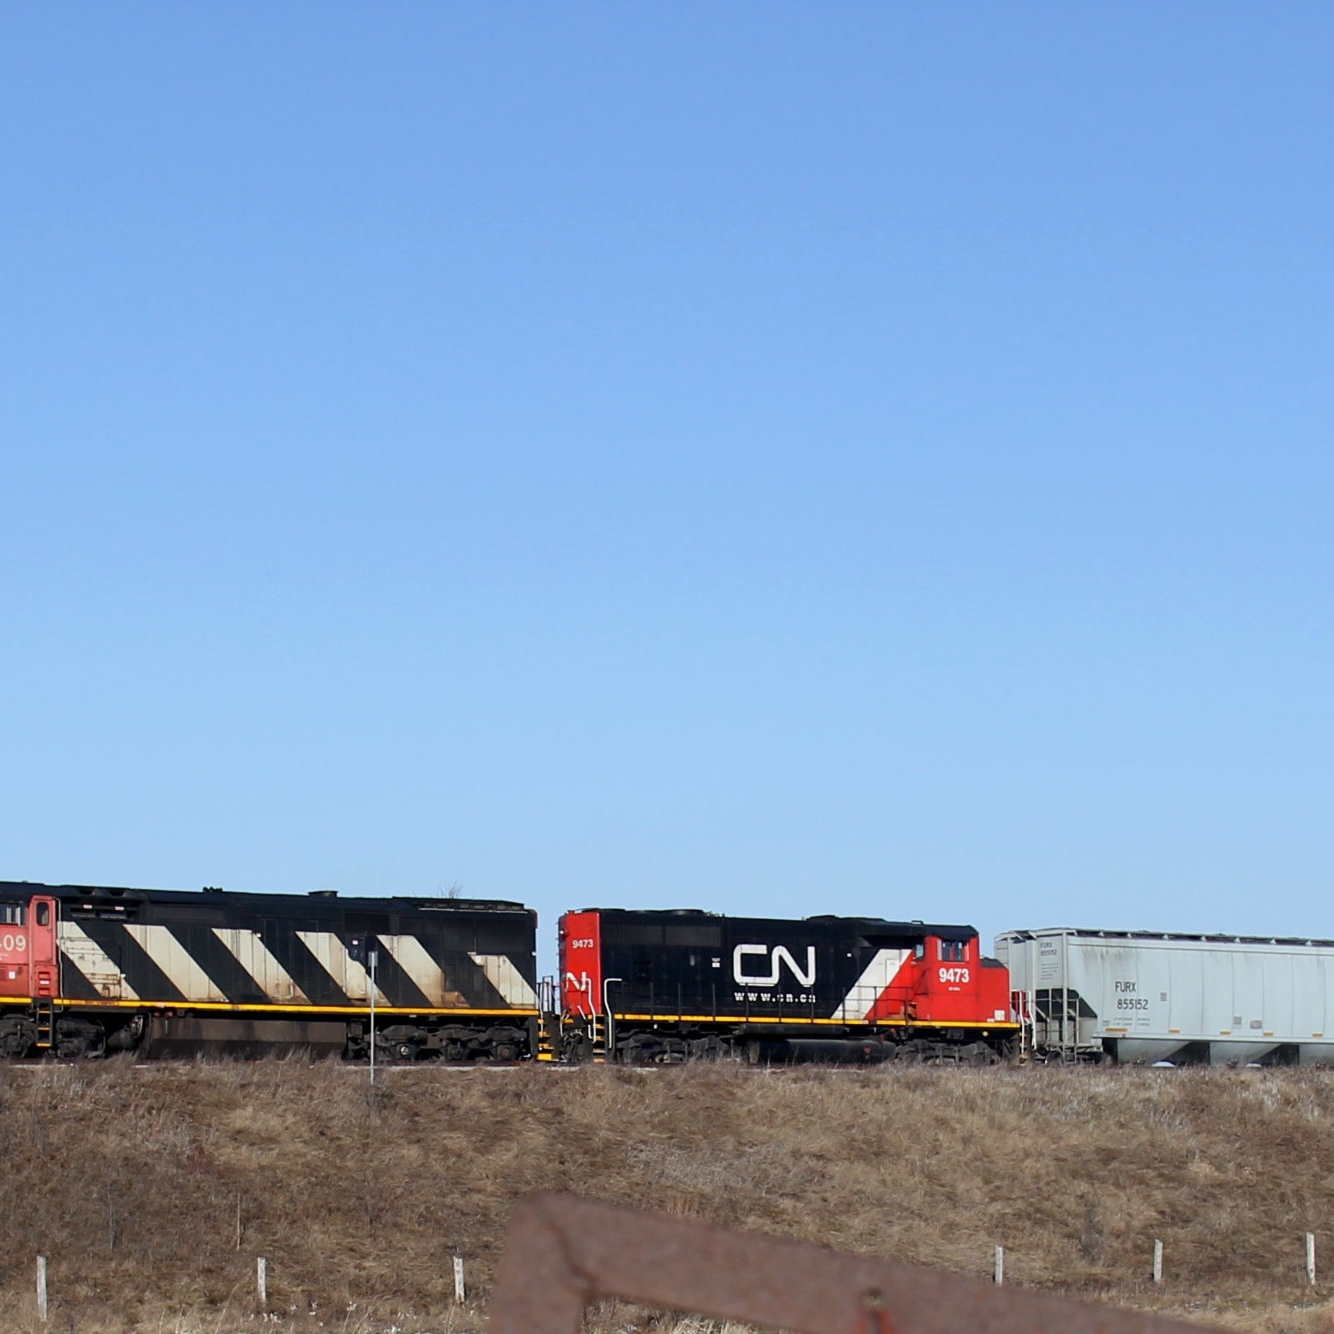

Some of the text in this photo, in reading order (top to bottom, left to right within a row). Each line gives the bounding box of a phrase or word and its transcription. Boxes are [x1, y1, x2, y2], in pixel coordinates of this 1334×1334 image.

[572, 939, 594, 949] 9473
[733, 944, 816, 987] CN
[938, 967, 970, 983] 9473
[1115, 981, 1136, 992] FURX
[734, 992, 816, 1003] www.cn.ca
[1117, 999, 1148, 1010] 855152
